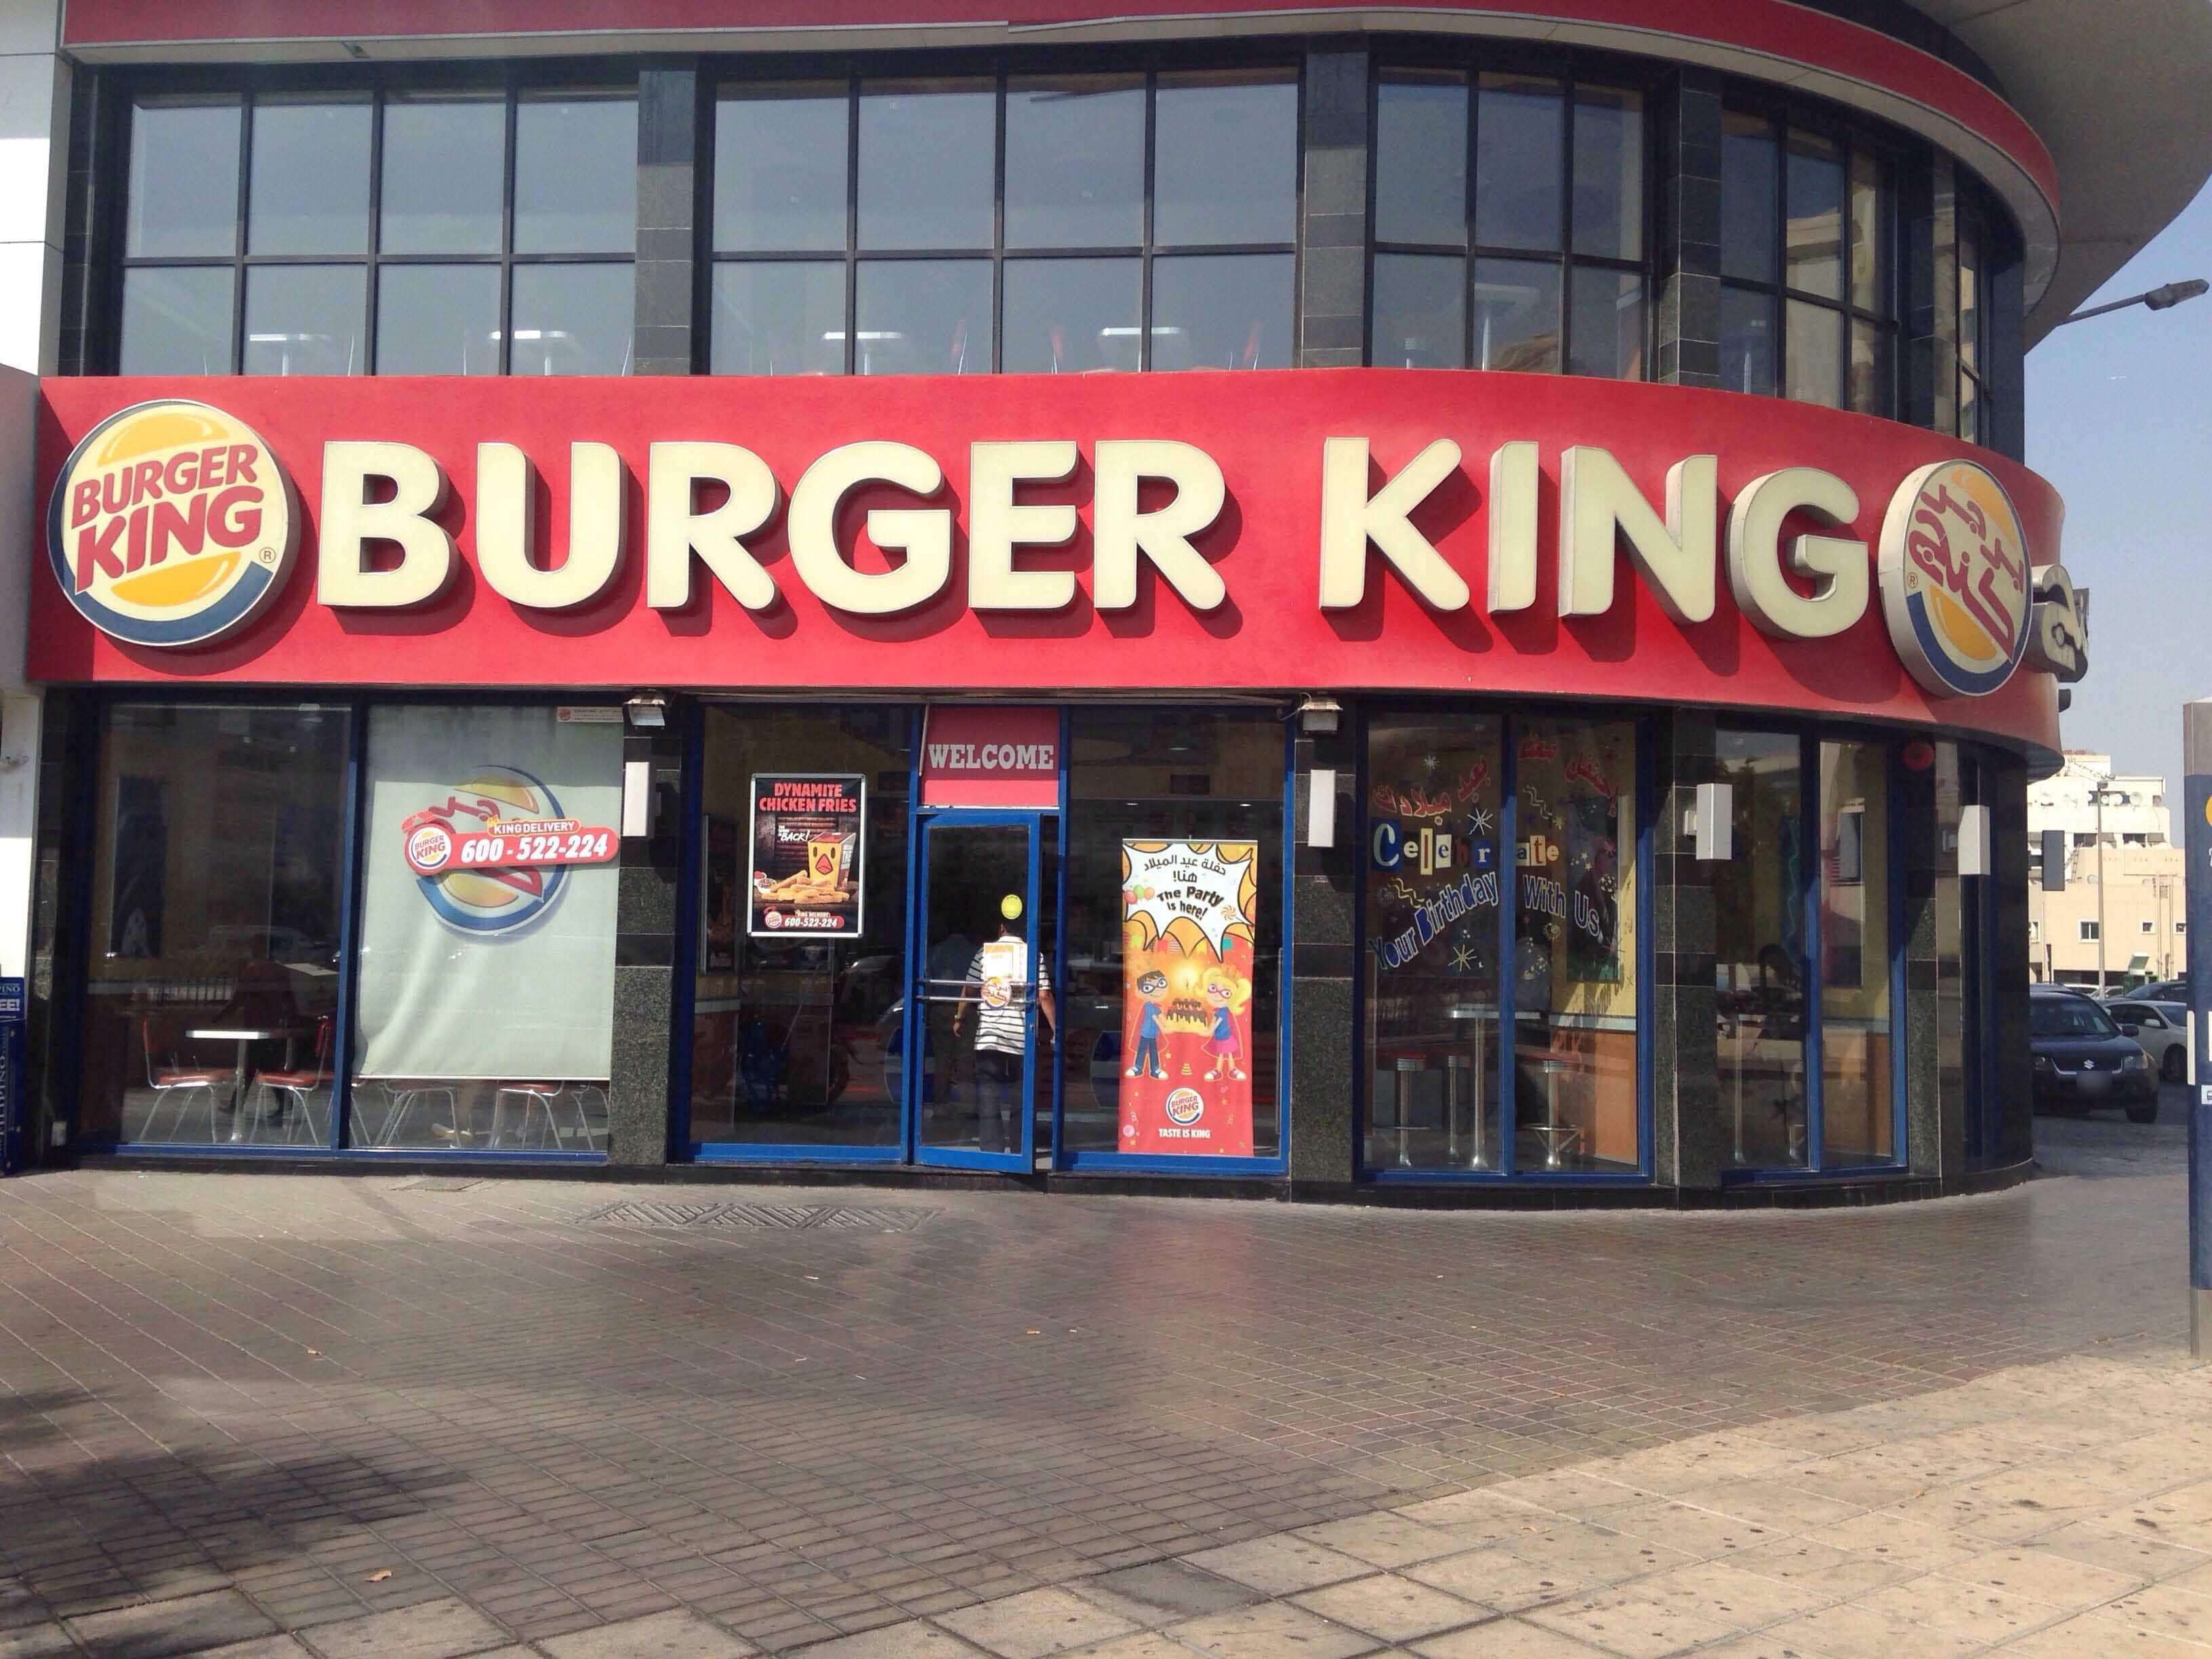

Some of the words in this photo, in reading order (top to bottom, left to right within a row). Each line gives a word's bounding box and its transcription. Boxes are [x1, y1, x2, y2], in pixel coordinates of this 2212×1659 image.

[71, 444, 259, 529] BURGER
[75, 485, 264, 595] KING
[317, 440, 1227, 615] BURGER
[1318, 436, 1870, 639] KING
[928, 743, 1054, 770] WELCOME
[774, 783, 842, 798] DYNAMITE
[759, 797, 816, 812] CHICKEN
[817, 798, 857, 813] FRIES
[493, 825, 521, 834] KING
[523, 821, 575, 833] DELIVERY
[780, 829, 811, 842] BACK!
[414, 834, 444, 851] BURGER
[415, 840, 446, 860] KING
[461, 838, 504, 863] 600
[515, 834, 608, 861] 522-224
[1144, 855, 1177, 871] الميلاد
[1180, 856, 1197, 868] عيد
[1202, 858, 1226, 876] حفلة
[1157, 889, 1181, 902] The
[1186, 886, 1225, 907] Party
[1523, 875, 1567, 919] With
[1179, 901, 1208, 920] here!
[784, 917, 838, 928] 600-522-224
[1368, 925, 1419, 970] Your
[1414, 870, 1498, 947] Birthday
[1171, 1096, 1197, 1107] BURGER
[1172, 1102, 1199, 1117] KING
[1158, 1128, 1181, 1138] TASTE
[1182, 1129, 1190, 1138] IS
[1191, 1129, 1210, 1139] KING
